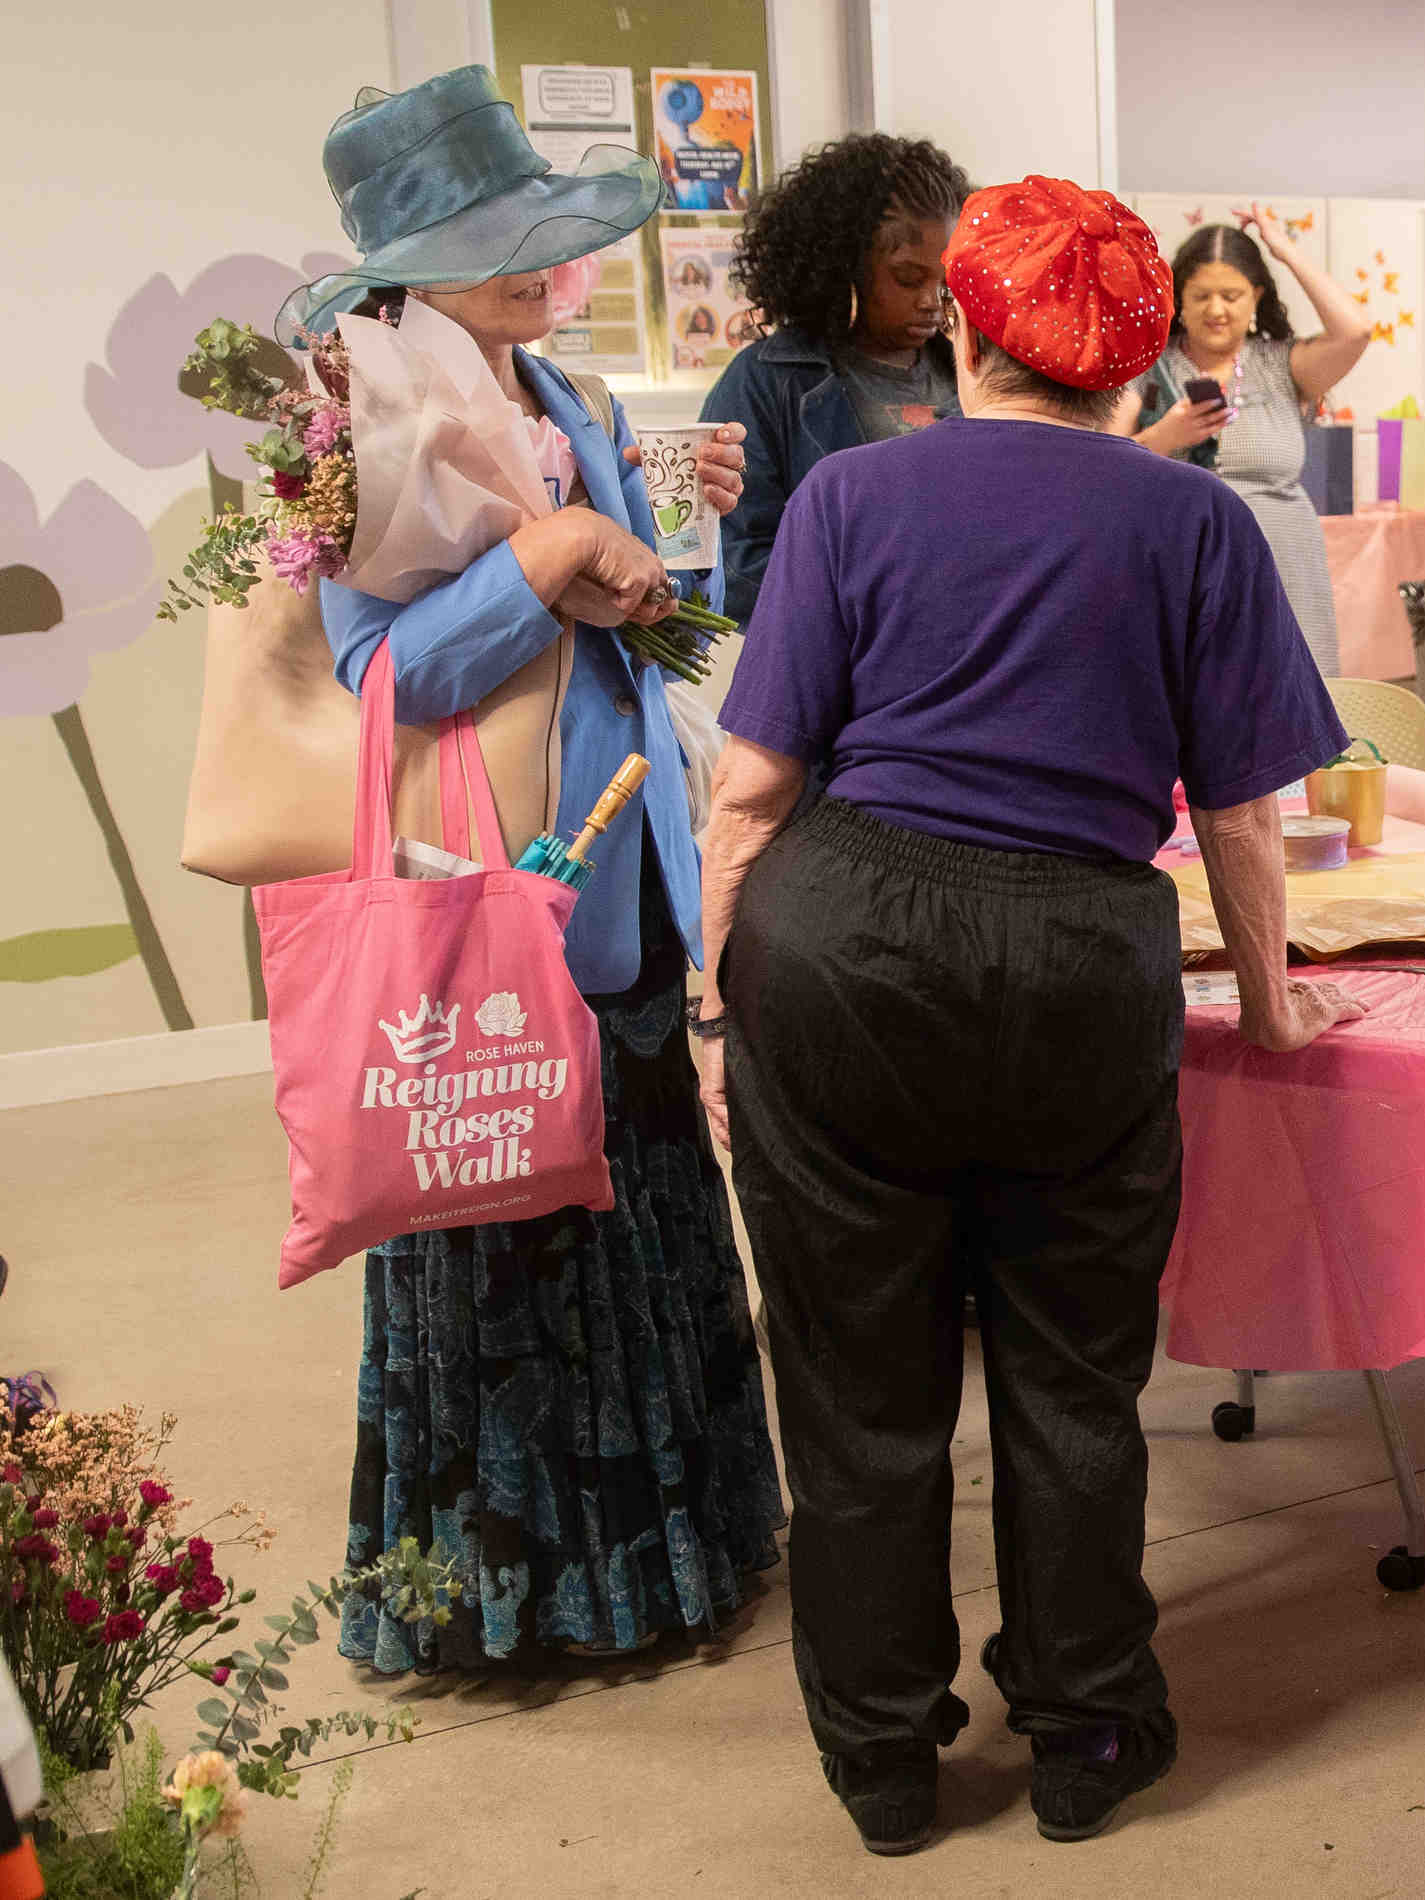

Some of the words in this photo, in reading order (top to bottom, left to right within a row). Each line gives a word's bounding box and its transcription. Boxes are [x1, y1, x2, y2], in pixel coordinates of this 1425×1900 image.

[466, 1048, 500, 1063] ROSE
[504, 1041, 545, 1057] HAVEN
[360, 1057, 568, 1116] Reigning
[403, 1105, 536, 1150] Roses
[409, 1136, 536, 1192] Walk
